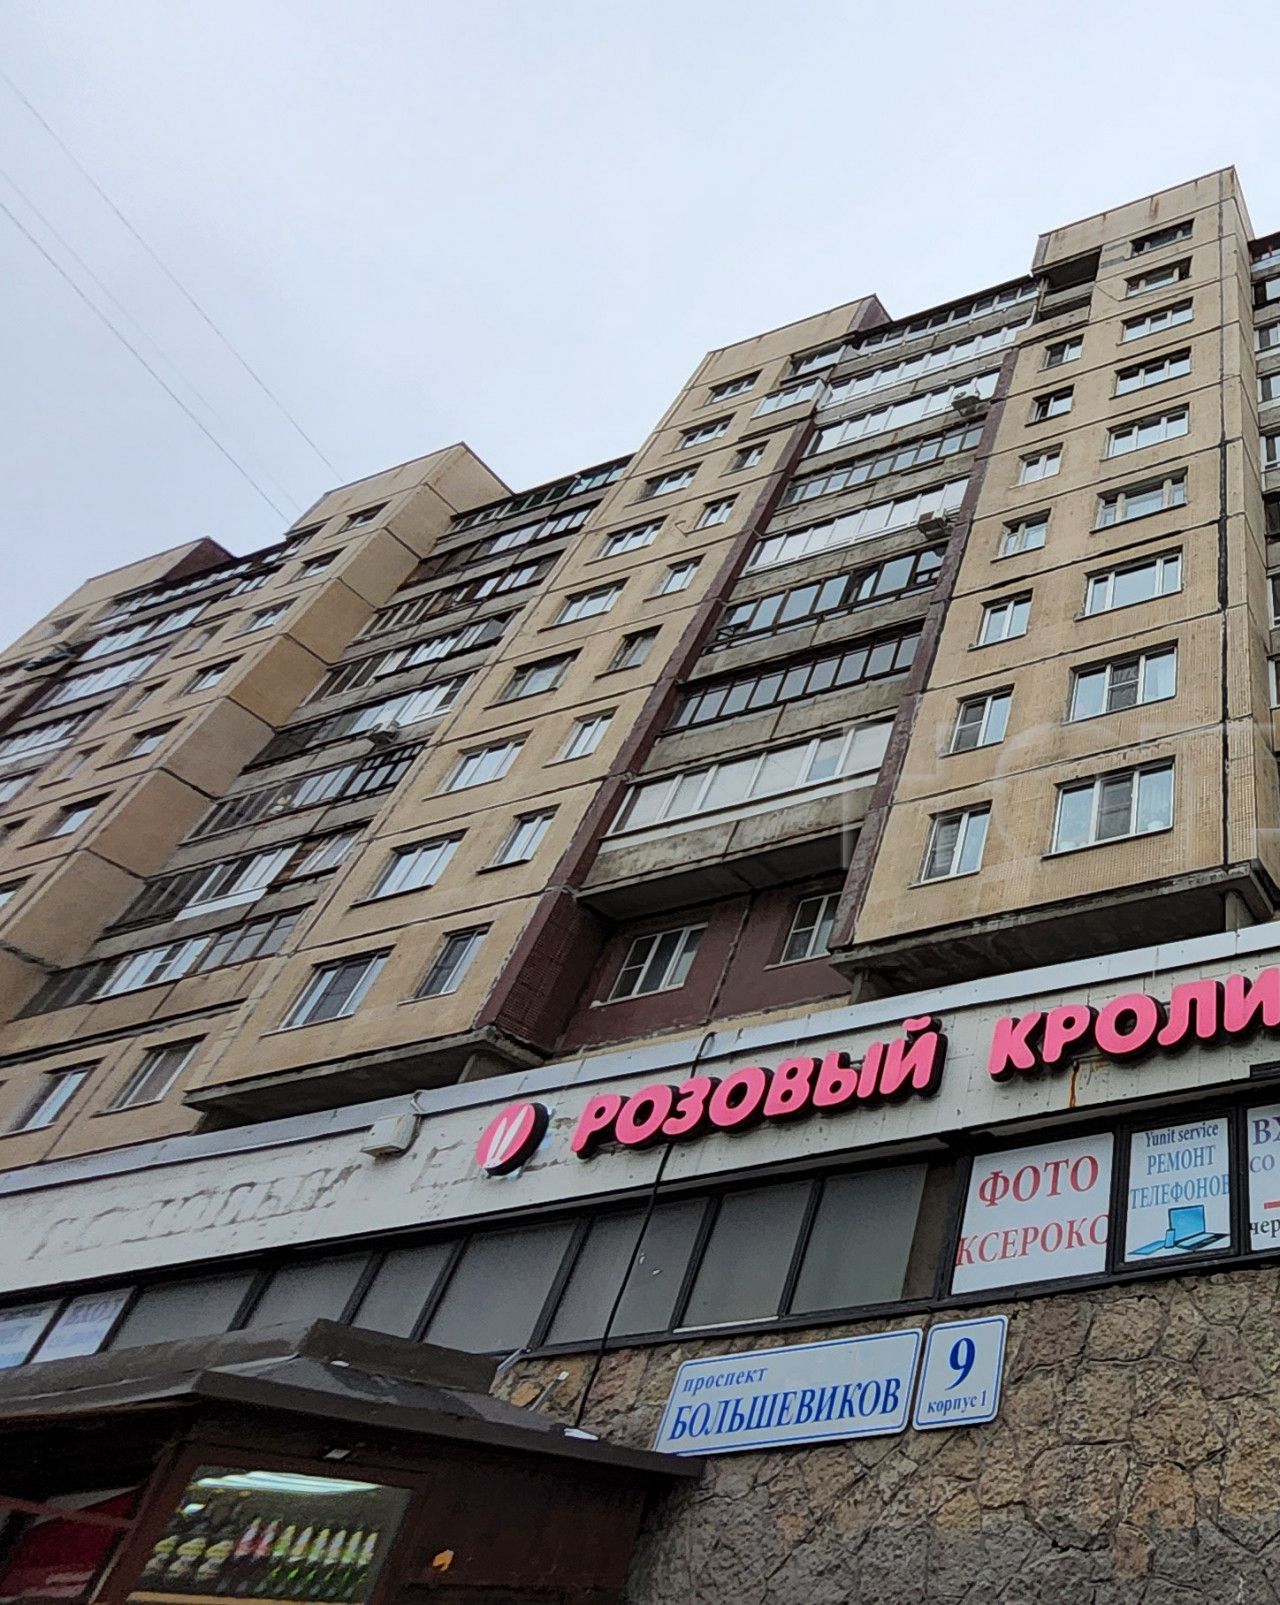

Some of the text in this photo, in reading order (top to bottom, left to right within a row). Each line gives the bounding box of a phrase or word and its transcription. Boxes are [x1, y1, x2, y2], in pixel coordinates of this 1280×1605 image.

[571, 1015, 940, 1153] РОЗОВЫЙ
[1145, 1122, 1219, 1148] Yunit service
[1146, 1144, 1217, 1176] РЕМОНТ
[1249, 1154, 1275, 1173] СО
[978, 1155, 1099, 1208] ФОТО
[944, 1337, 976, 1391] 9
[682, 1367, 768, 1396] проспект
[667, 1377, 902, 1442] БОЛЬШЕВИКОВ
[926, 1390, 987, 1415] корпус 1
